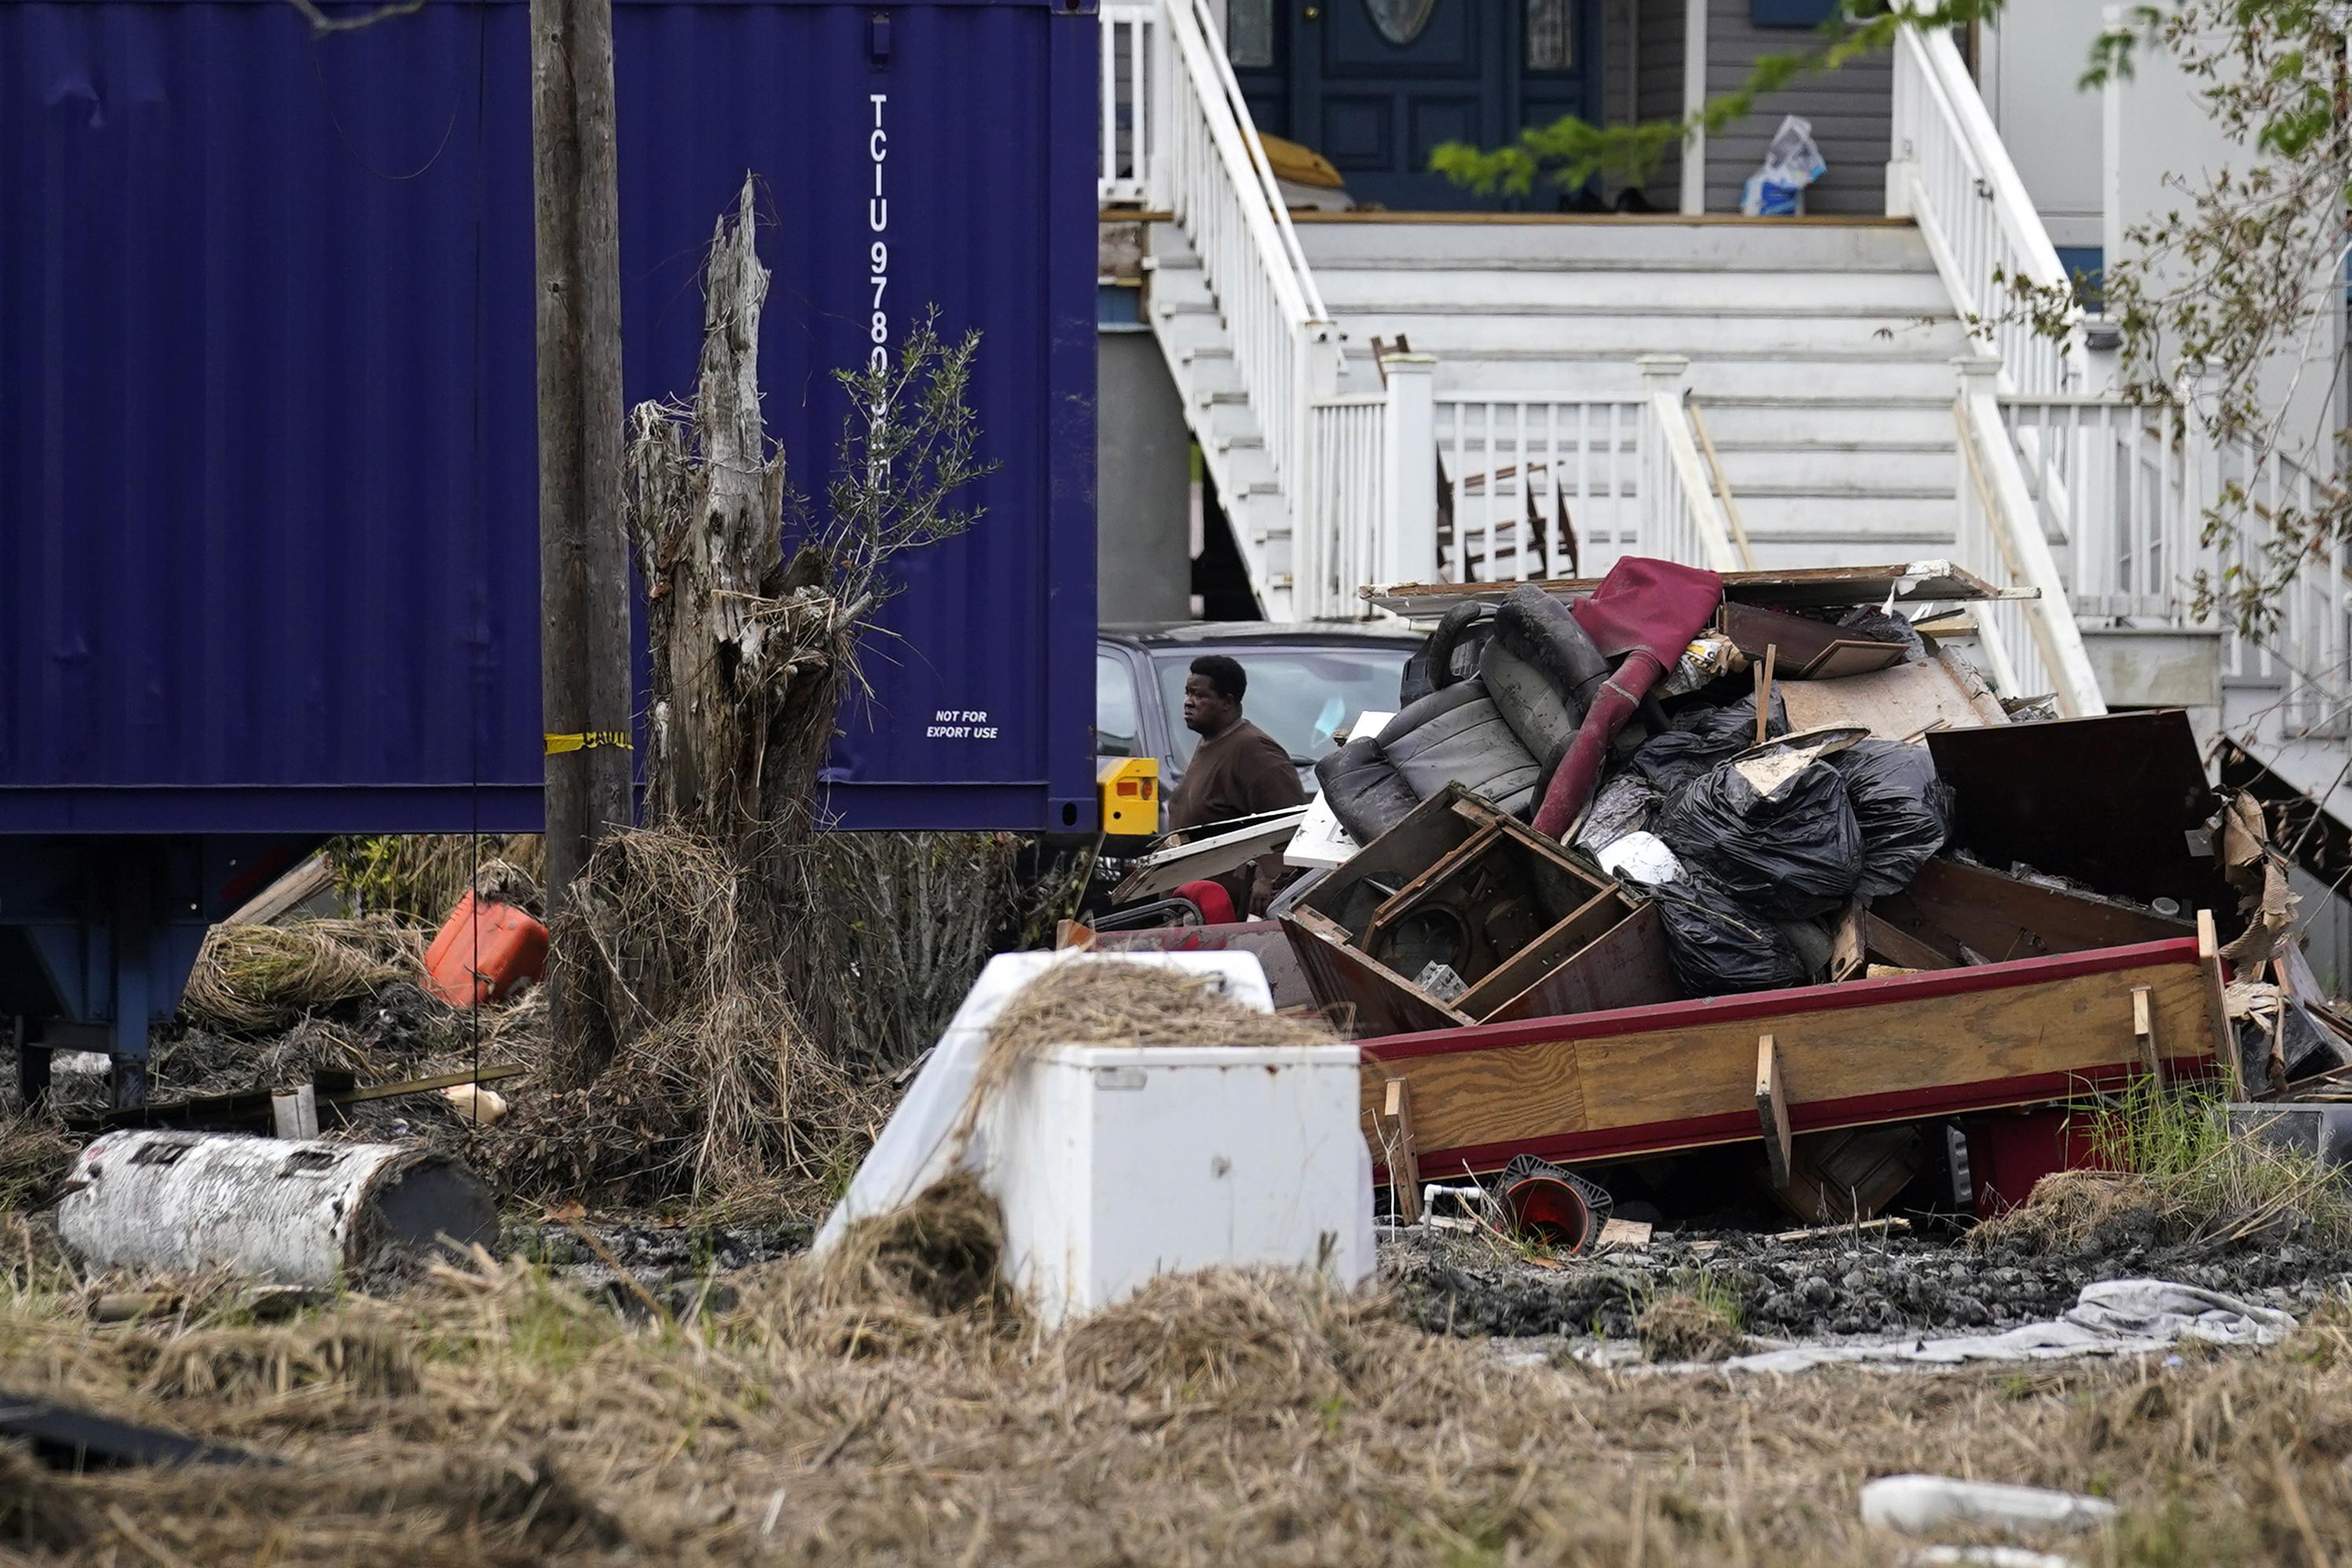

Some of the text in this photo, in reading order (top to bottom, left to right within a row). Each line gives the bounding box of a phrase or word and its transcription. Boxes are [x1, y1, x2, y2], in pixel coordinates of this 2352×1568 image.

[870, 93, 888, 233] TCIU
[936, 710, 987, 723] NOT FOR
[926, 726, 998, 738] EXPORT USE
